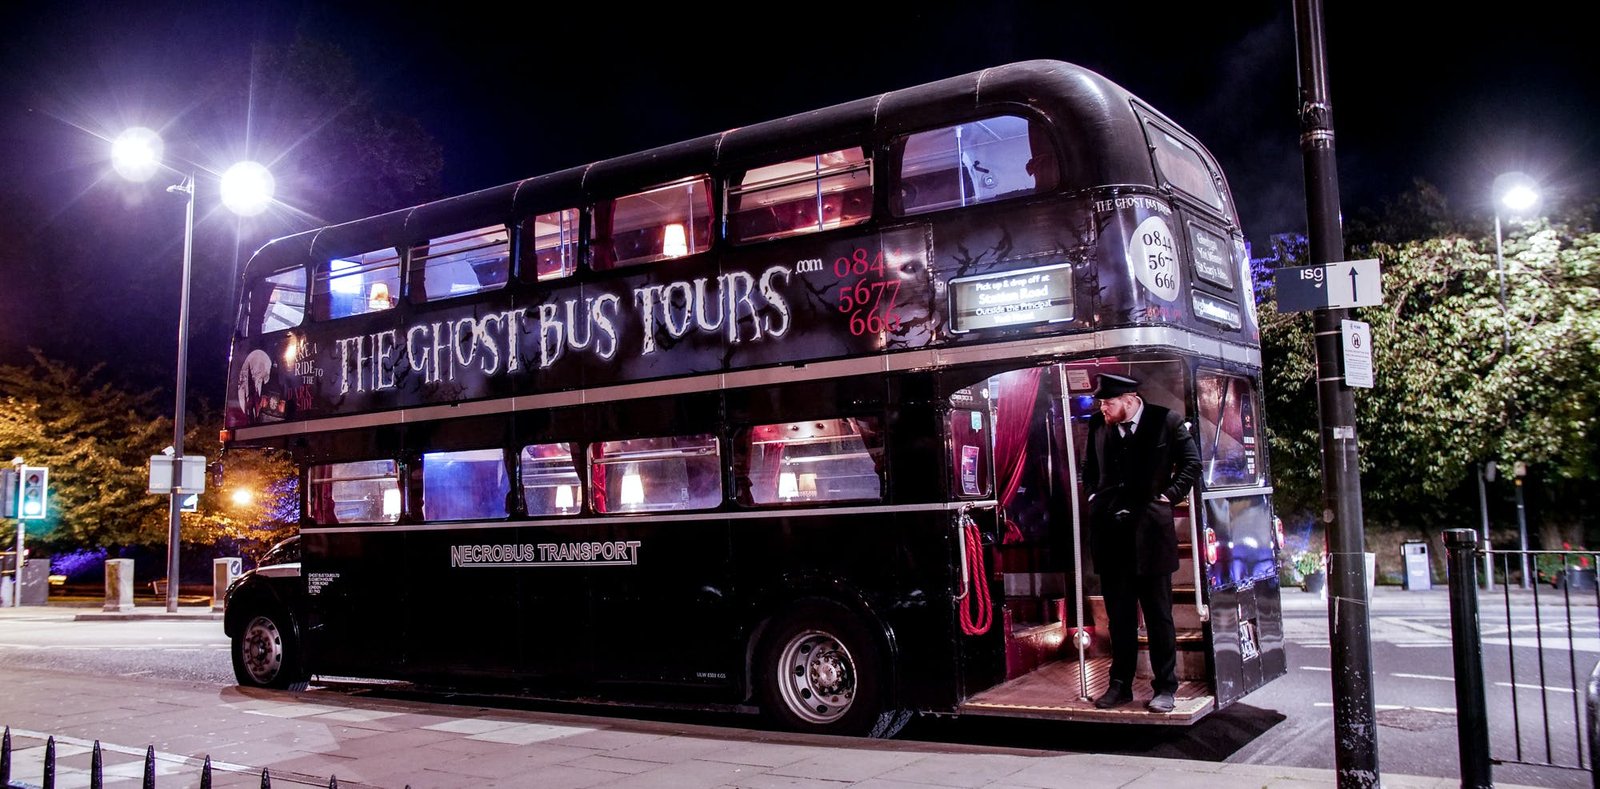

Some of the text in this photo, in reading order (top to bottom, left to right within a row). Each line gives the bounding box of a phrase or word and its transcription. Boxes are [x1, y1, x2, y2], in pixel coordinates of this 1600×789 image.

[1095, 199, 1114, 212] THE
[1114, 197, 1144, 209] GHOST
[1142, 231, 1173, 254] 0844
[1155, 272, 1175, 289] 666
[1300, 267, 1324, 282] isg
[975, 282, 991, 292] Pick
[992, 282, 1002, 291] up
[1010, 278, 1027, 287] drop
[1028, 275, 1040, 284] off
[838, 278, 902, 313] 5677
[975, 305, 1005, 316] Outside
[335, 258, 824, 395] THE GHOST BUS TOURS .com
[849, 304, 902, 336] 666
[294, 360, 324, 377] RIDE TO
[302, 376, 315, 386] THE
[451, 541, 641, 567] NECROBUS TRANSPORT
